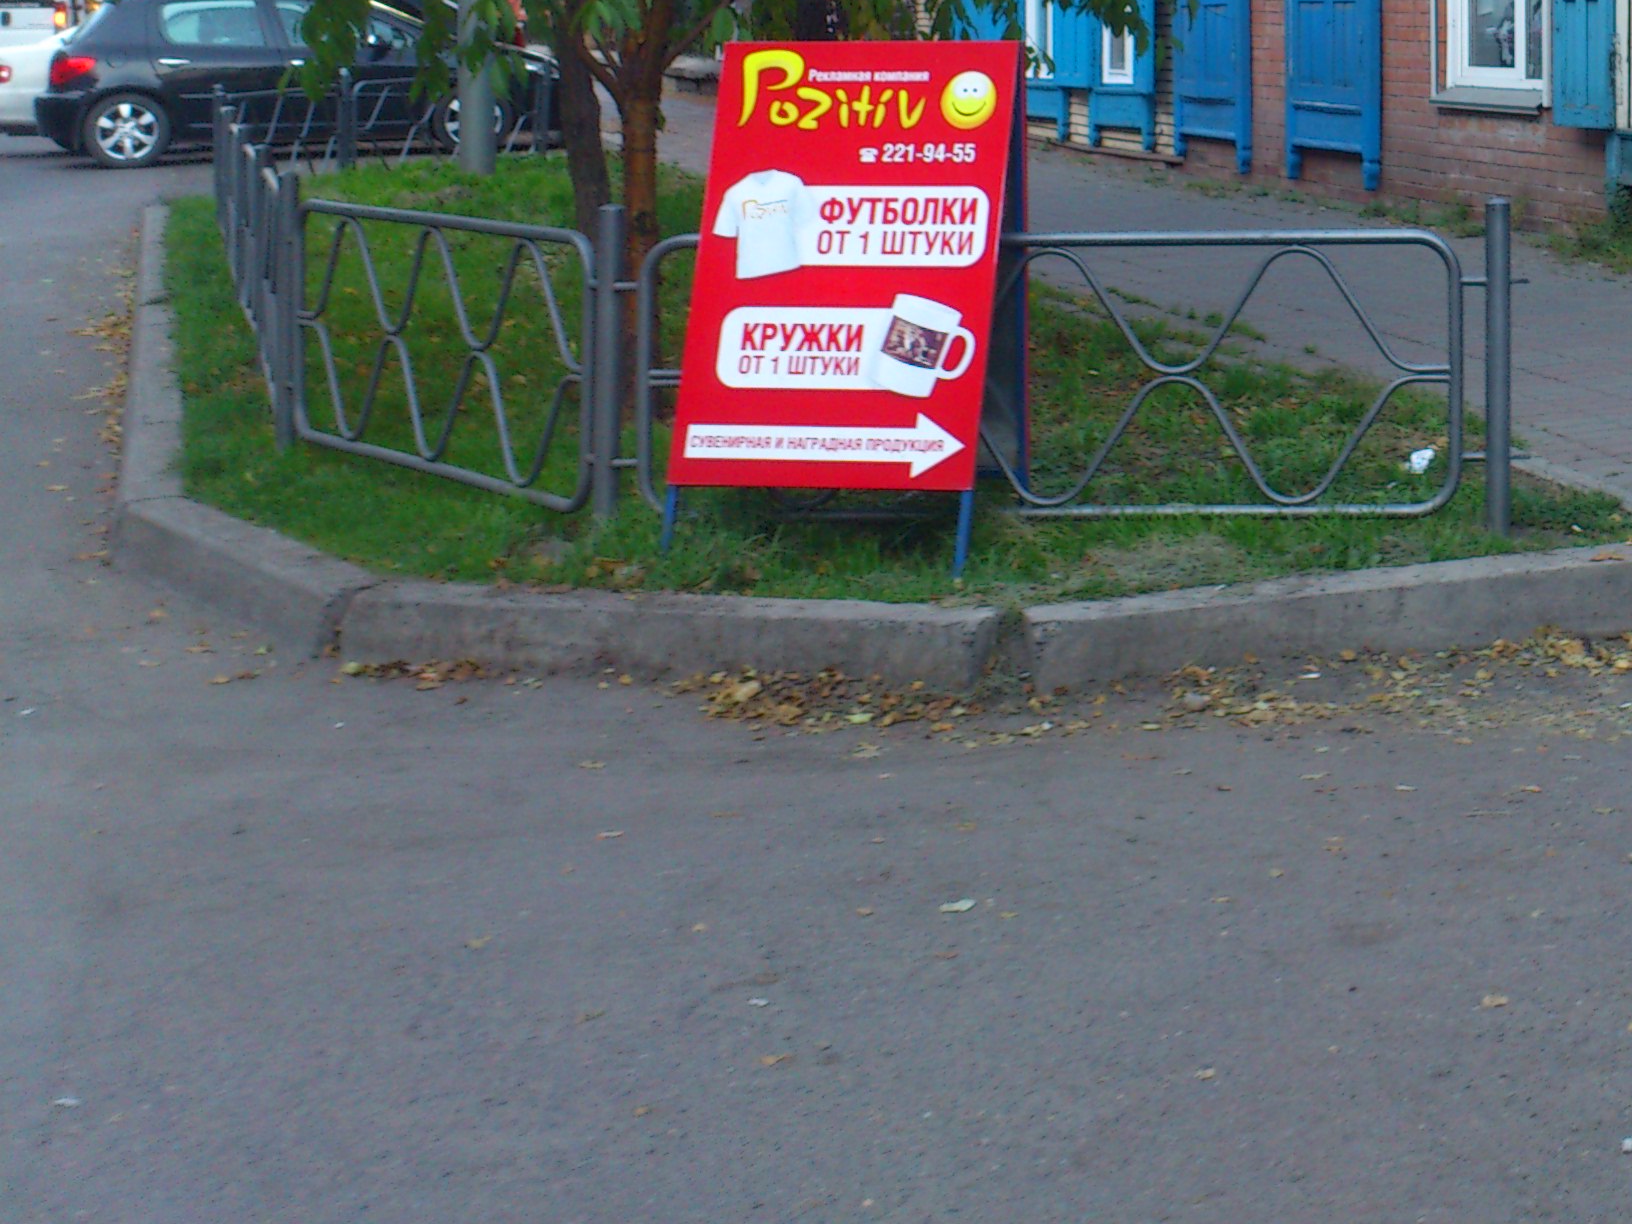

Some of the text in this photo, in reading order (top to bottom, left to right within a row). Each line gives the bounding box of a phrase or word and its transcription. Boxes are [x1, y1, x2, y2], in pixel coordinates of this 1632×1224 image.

[808, 68, 930, 82] Рекламная компания
[881, 143, 976, 163] 221-94-55
[819, 197, 979, 225] ФУТБОЛКИ
[817, 230, 975, 255] ОТ 1 ШТУКИ
[740, 323, 865, 352] КРУЖКИ
[738, 355, 861, 376] ОТ 1 ШТУКИ
[690, 435, 945, 453] СУВЕНИРНАЯ И НАГРАДНАЯ ПРОДУКЦИЯ
